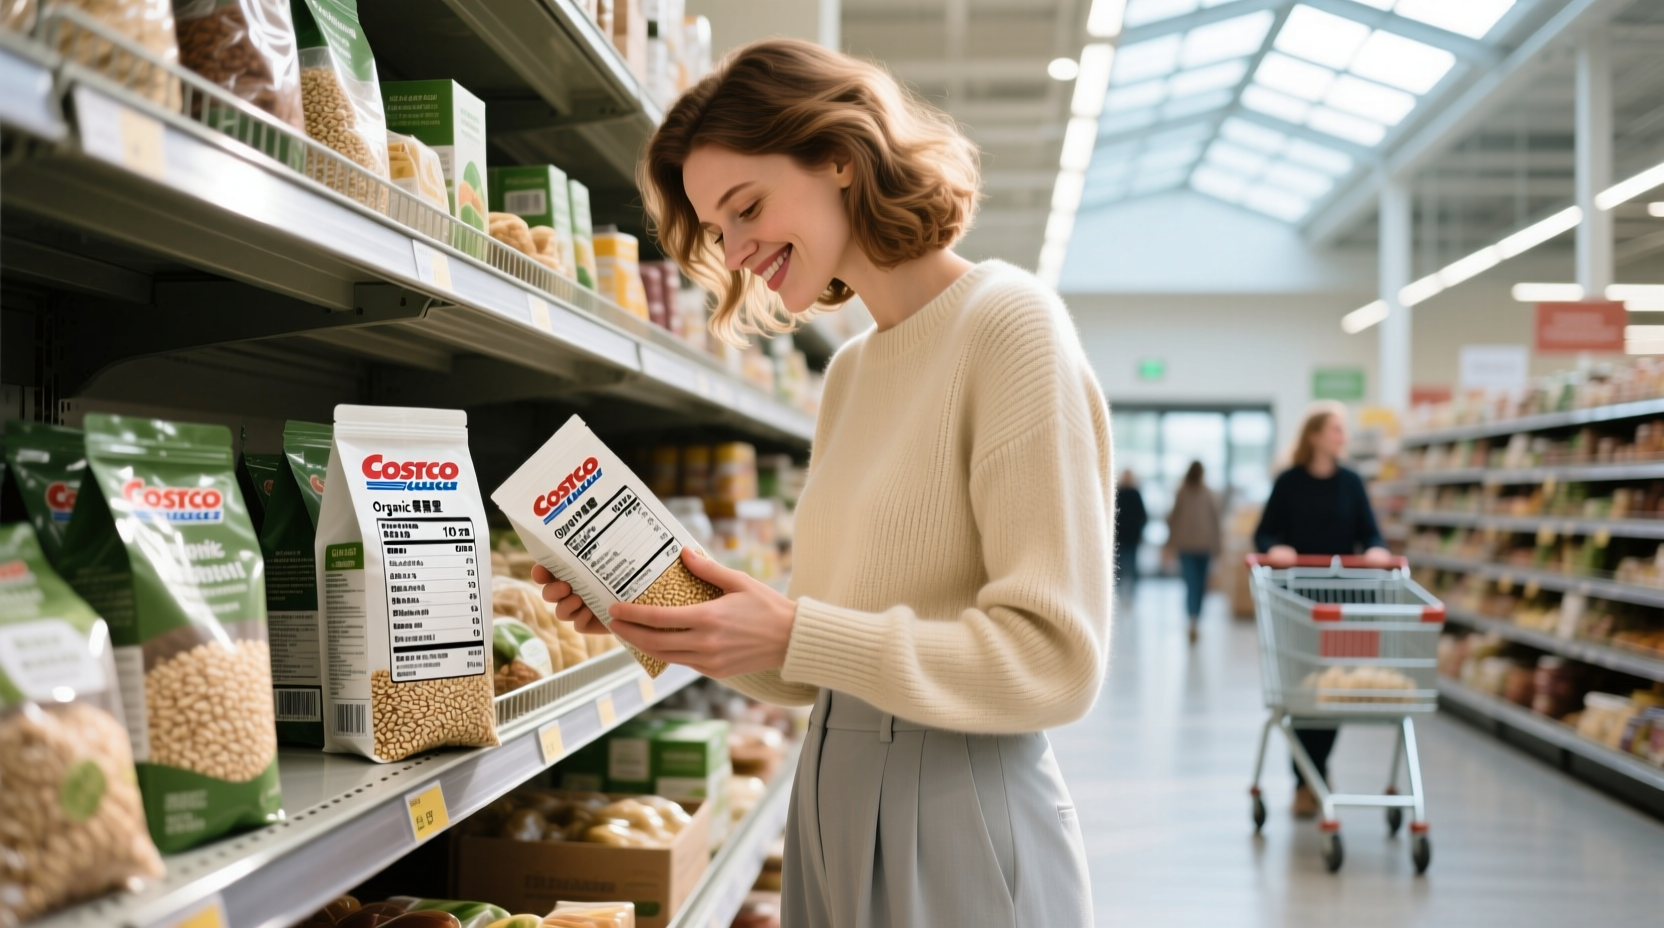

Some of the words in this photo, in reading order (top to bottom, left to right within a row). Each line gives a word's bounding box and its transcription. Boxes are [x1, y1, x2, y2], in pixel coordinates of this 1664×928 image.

[362, 454, 459, 480] COSTCO
[122, 477, 222, 510] COSTCO
[533, 457, 598, 517] COSTCO
